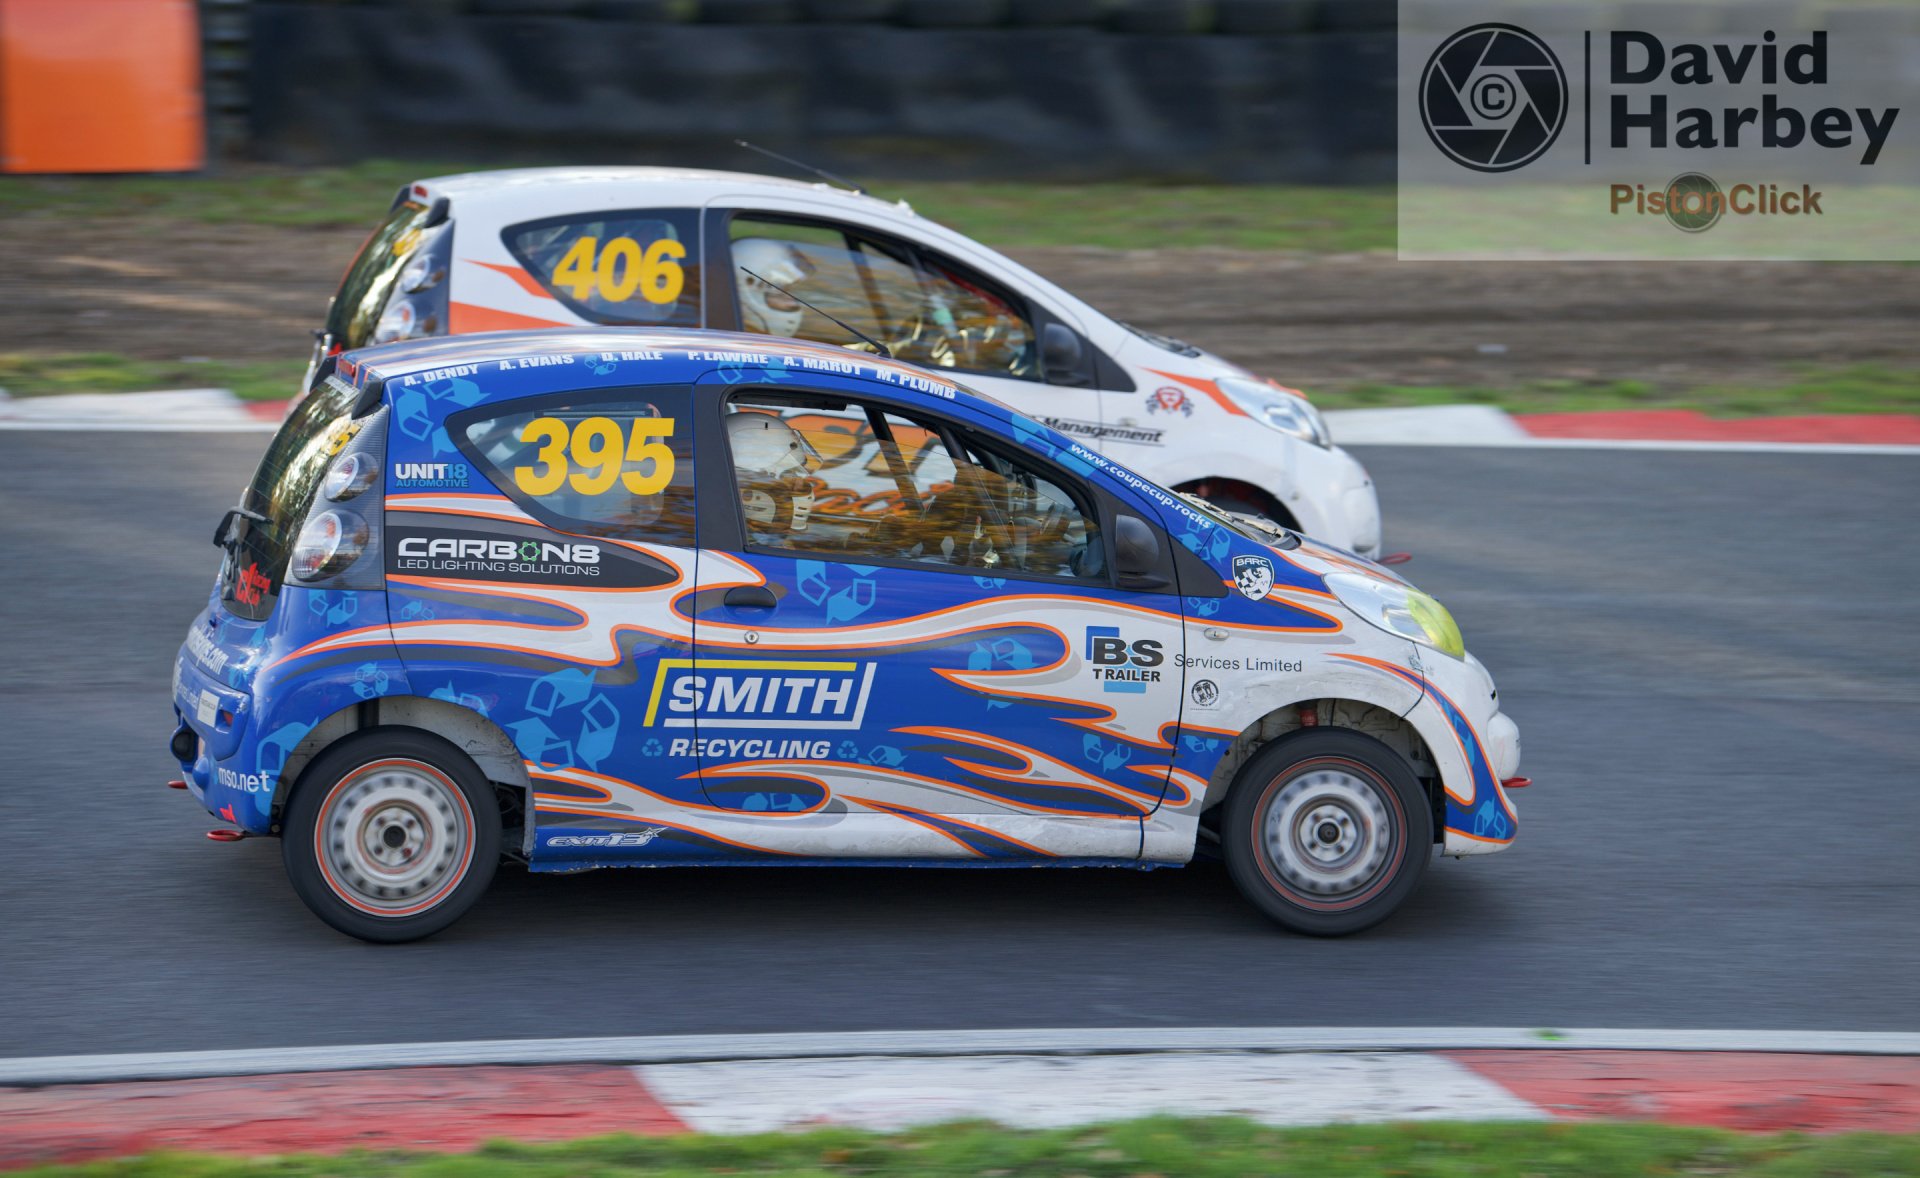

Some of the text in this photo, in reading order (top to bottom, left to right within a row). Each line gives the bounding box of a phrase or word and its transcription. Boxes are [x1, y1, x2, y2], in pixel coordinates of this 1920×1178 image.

[552, 236, 687, 305] 406
[404, 350, 957, 400] A. DENDY A. EVANS D. HALE P. LAWRIE A. MAROT M. PLUMB
[514, 416, 675, 496] 395
[395, 463, 468, 479] UNIT18
[396, 479, 468, 488] AUTOMOTIVE
[1070, 443, 1212, 529] www.coupecup.rocks
[398, 537, 600, 564] CARBON8
[1236, 557, 1269, 568] BARC
[398, 559, 600, 576] LED LIGHTING SOLUTIONS
[1174, 653, 1302, 673] Services Limited
[668, 676, 854, 715] SMITH
[668, 738, 831, 759] RECYCLING
